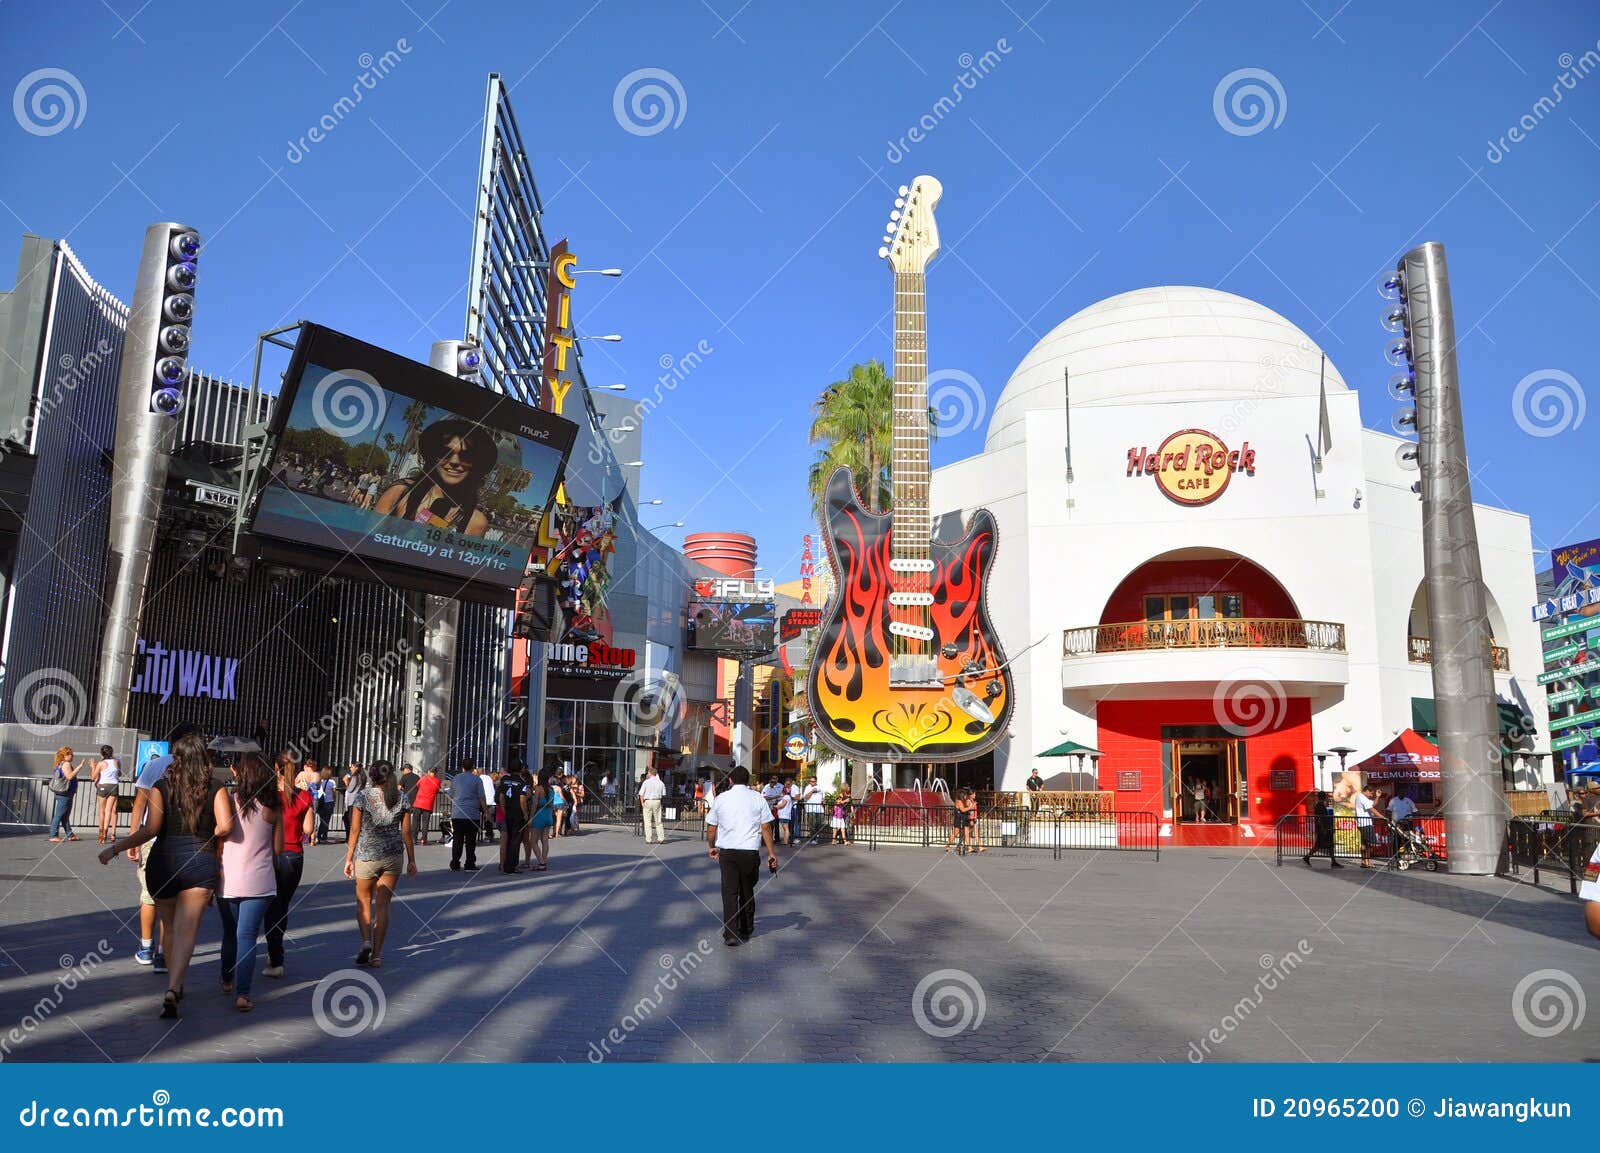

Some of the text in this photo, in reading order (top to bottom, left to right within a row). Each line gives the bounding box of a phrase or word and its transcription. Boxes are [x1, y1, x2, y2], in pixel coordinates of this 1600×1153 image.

[1127, 442, 1256, 477] Hard Rock
[1177, 478, 1210, 490] CAFE
[373, 533, 437, 556] saturday
[440, 548, 453, 559] at
[458, 539, 488, 551] over
[800, 535, 814, 604] SAMBA
[1561, 594, 1577, 612] GREAT
[546, 641, 636, 668] ameStop
